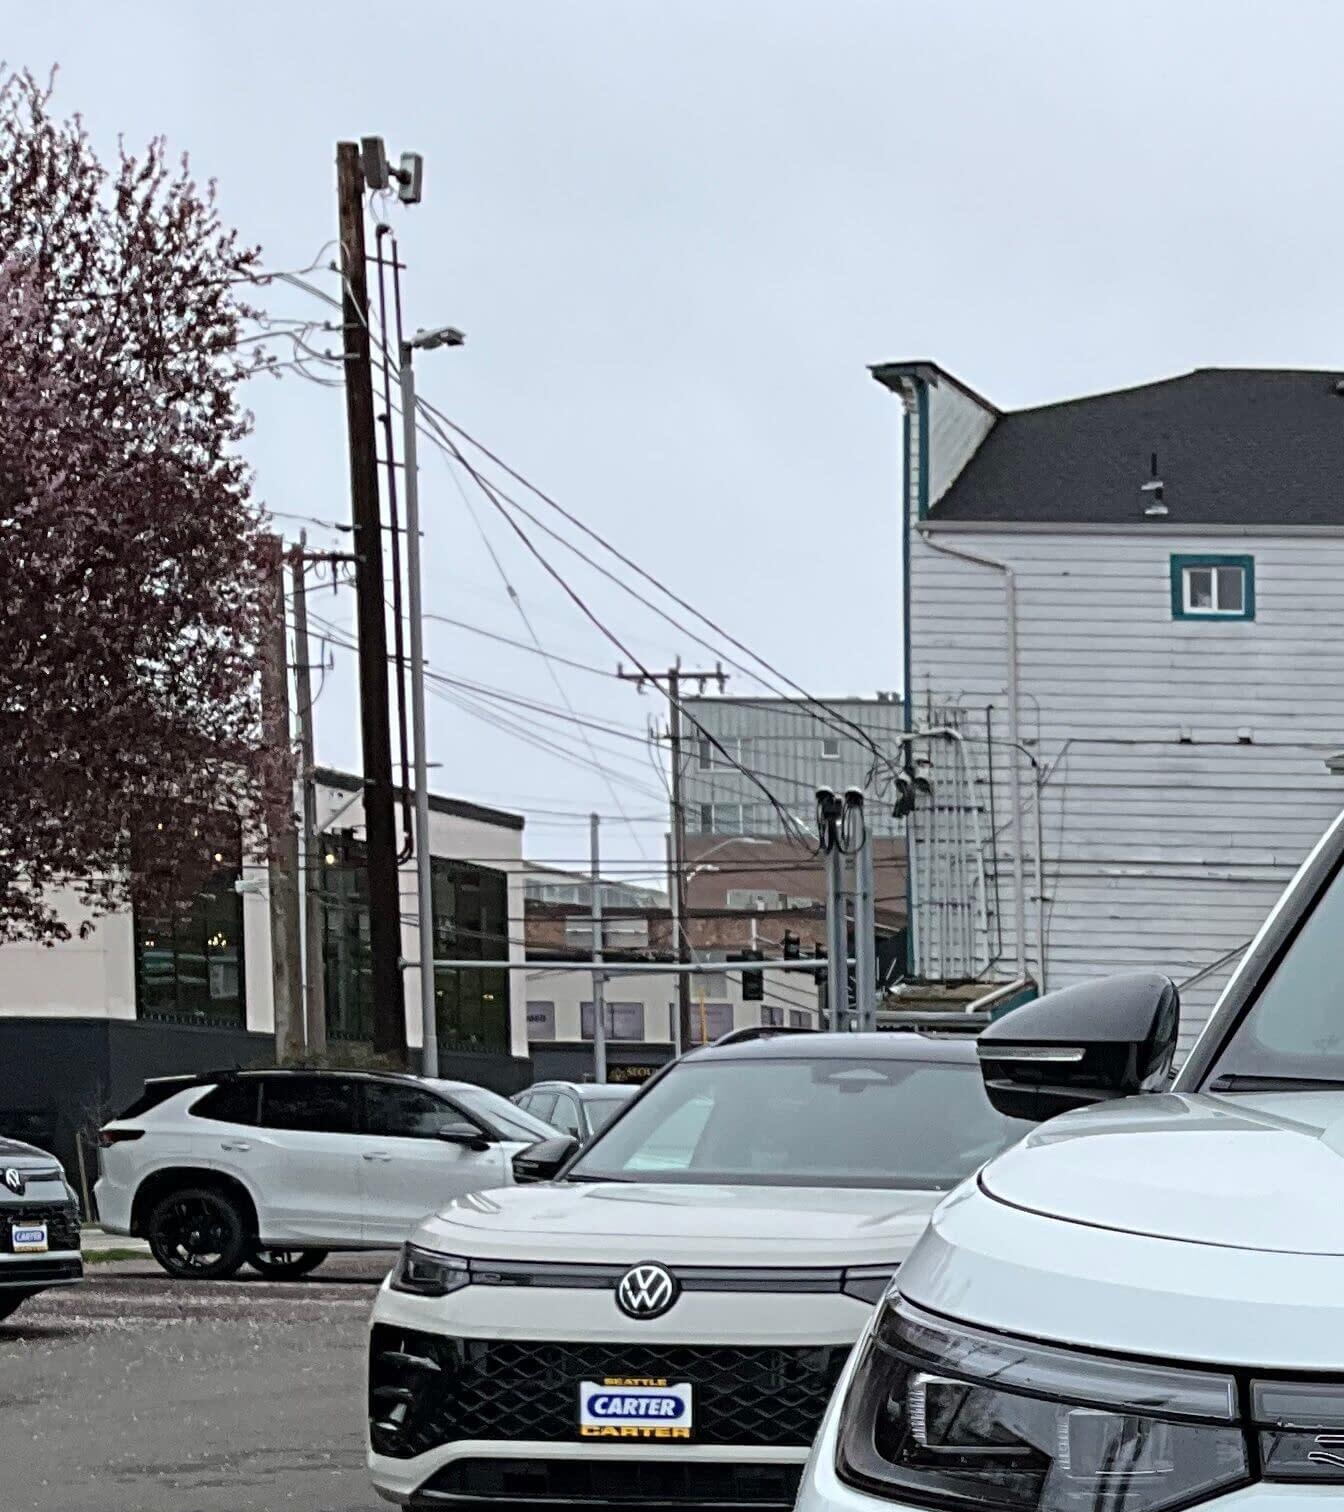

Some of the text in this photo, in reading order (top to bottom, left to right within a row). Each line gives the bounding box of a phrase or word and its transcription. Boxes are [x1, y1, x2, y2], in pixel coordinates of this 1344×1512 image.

[620, 1265, 672, 1313] VW
[603, 1378, 667, 1386] SEATTLE
[594, 1397, 676, 1416] CARTER
[581, 1426, 690, 1438] CARTER
